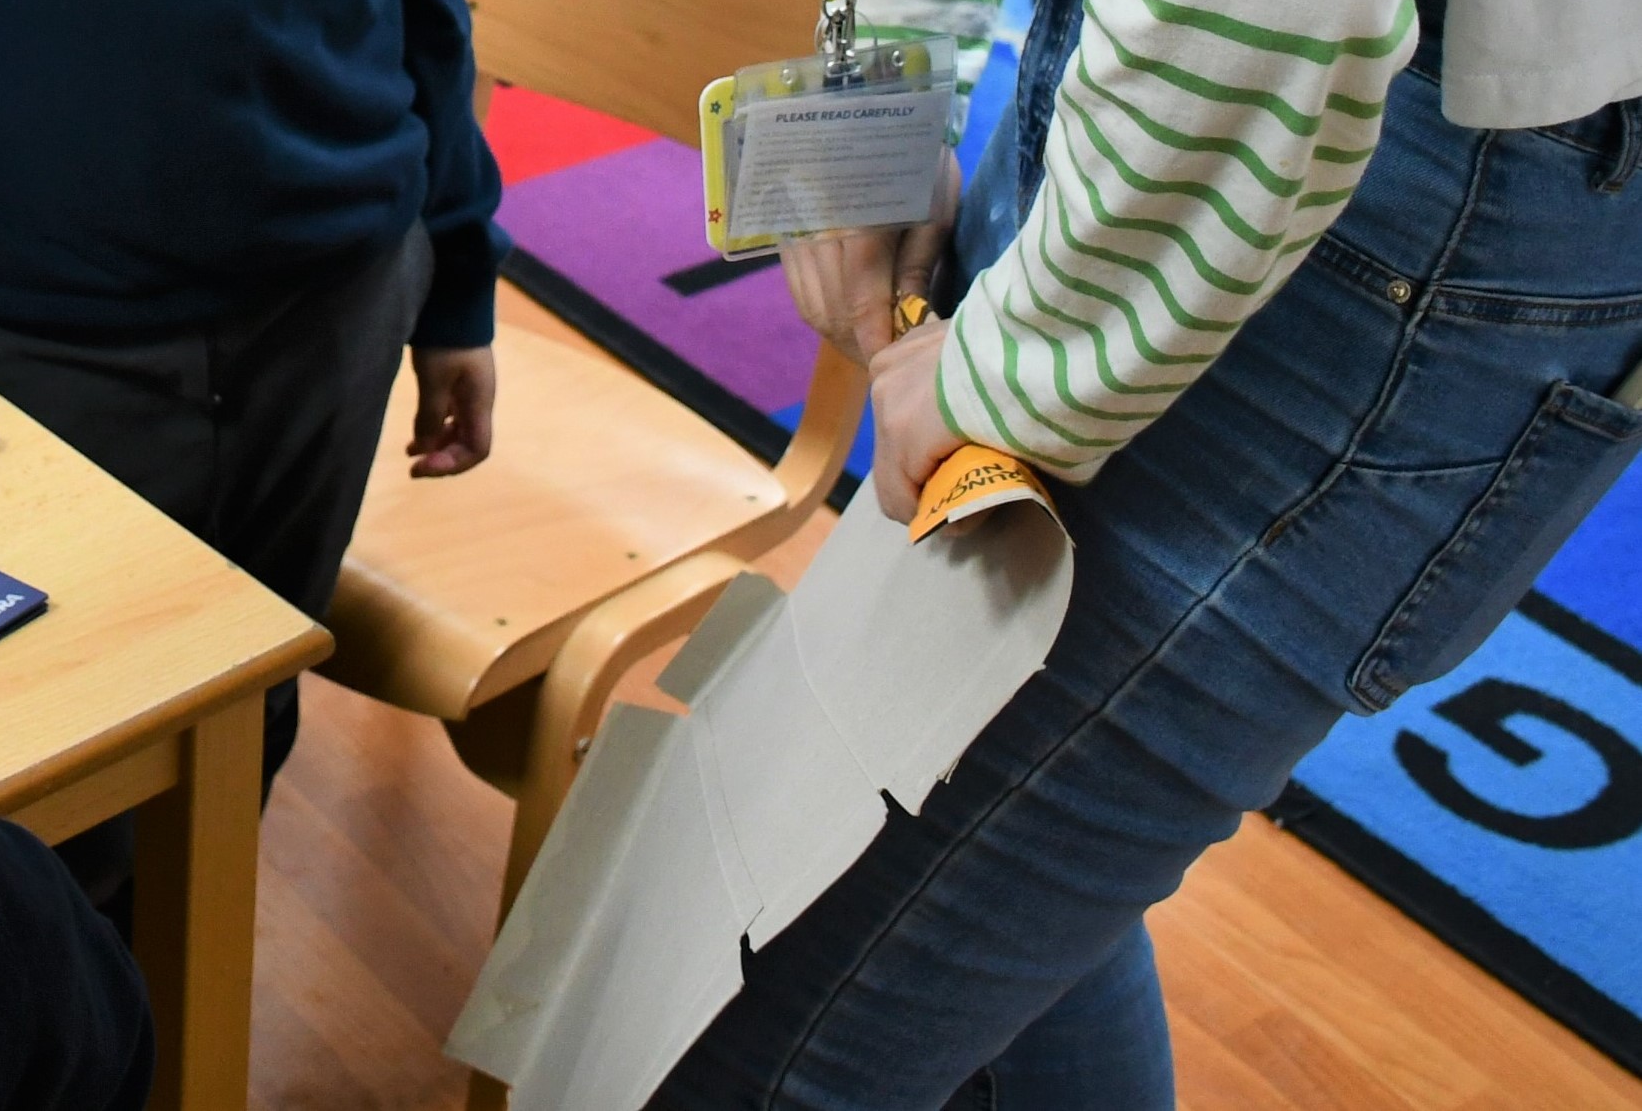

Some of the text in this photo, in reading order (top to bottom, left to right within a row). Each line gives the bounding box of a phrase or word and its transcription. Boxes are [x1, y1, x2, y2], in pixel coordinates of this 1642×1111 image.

[776, 106, 915, 122] PLEASE READ CAREFULLY
[1394, 677, 1642, 850] G
